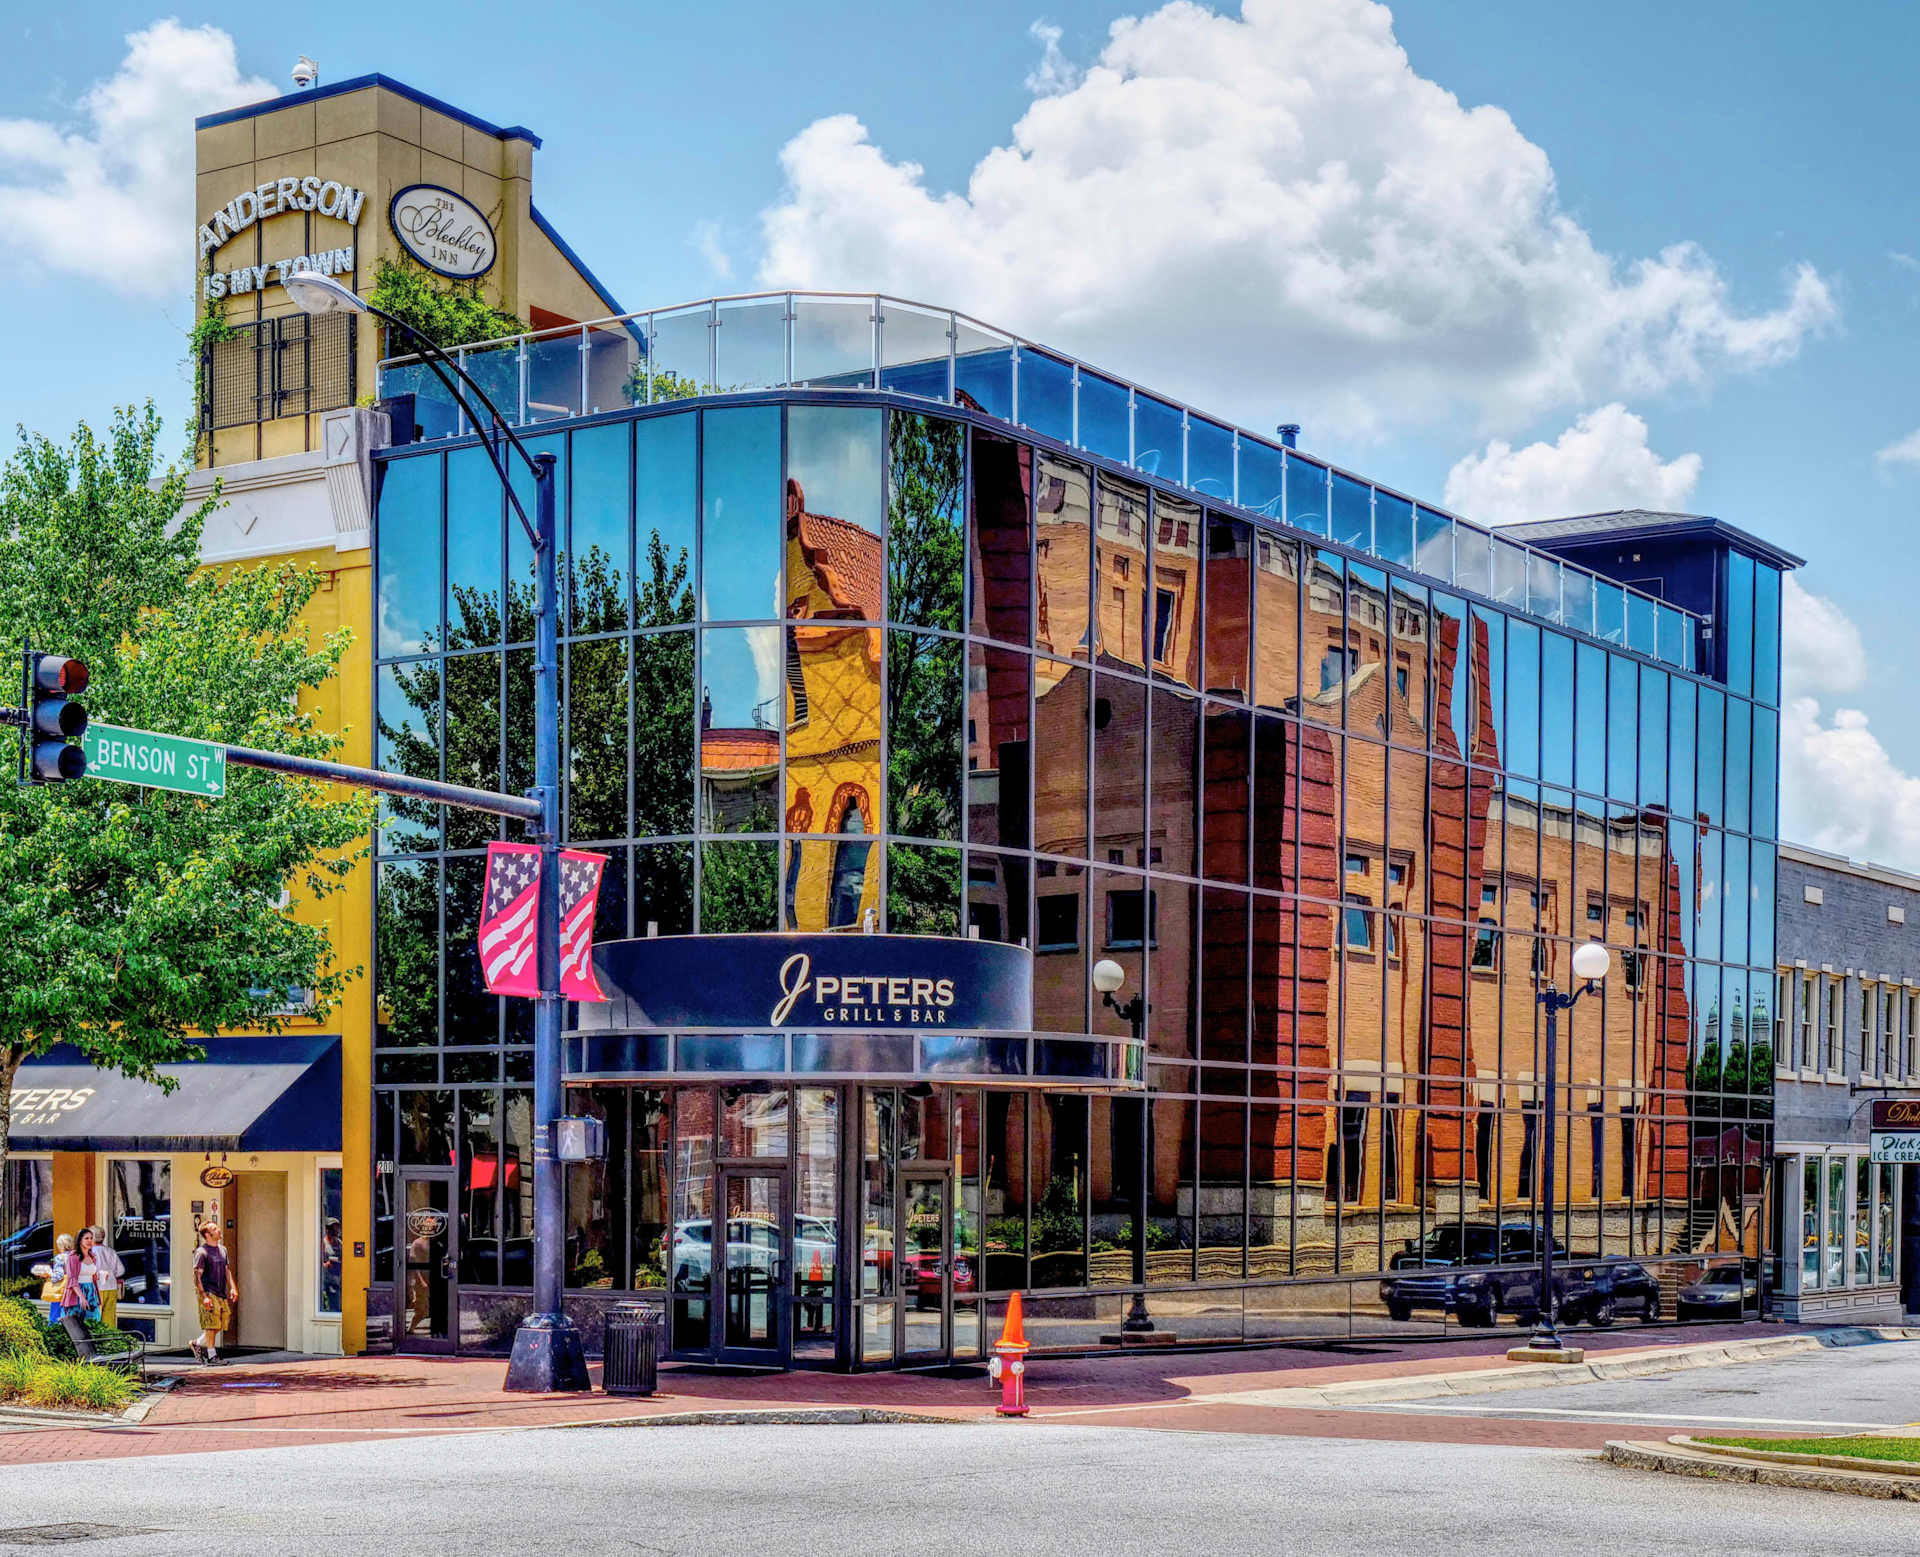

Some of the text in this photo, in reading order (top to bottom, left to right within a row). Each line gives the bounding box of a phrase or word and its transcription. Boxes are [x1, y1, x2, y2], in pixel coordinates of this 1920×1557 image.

[435, 197, 455, 213] THE
[198, 175, 367, 261] ANDERSON
[400, 205, 487, 271] Bleckley
[431, 245, 459, 266] INN
[203, 245, 355, 300] IS MY TOWN
[97, 738, 211, 782] BENSON ST
[213, 747, 225, 764] W
[770, 953, 955, 1027] J PETERS
[823, 1008, 946, 1024] GRILL & BAR
[20, 1112, 62, 1125] BAR
[1873, 1151, 1889, 1161] ICE
[378, 1161, 394, 1173] 200
[126, 1220, 167, 1232] PETERS
